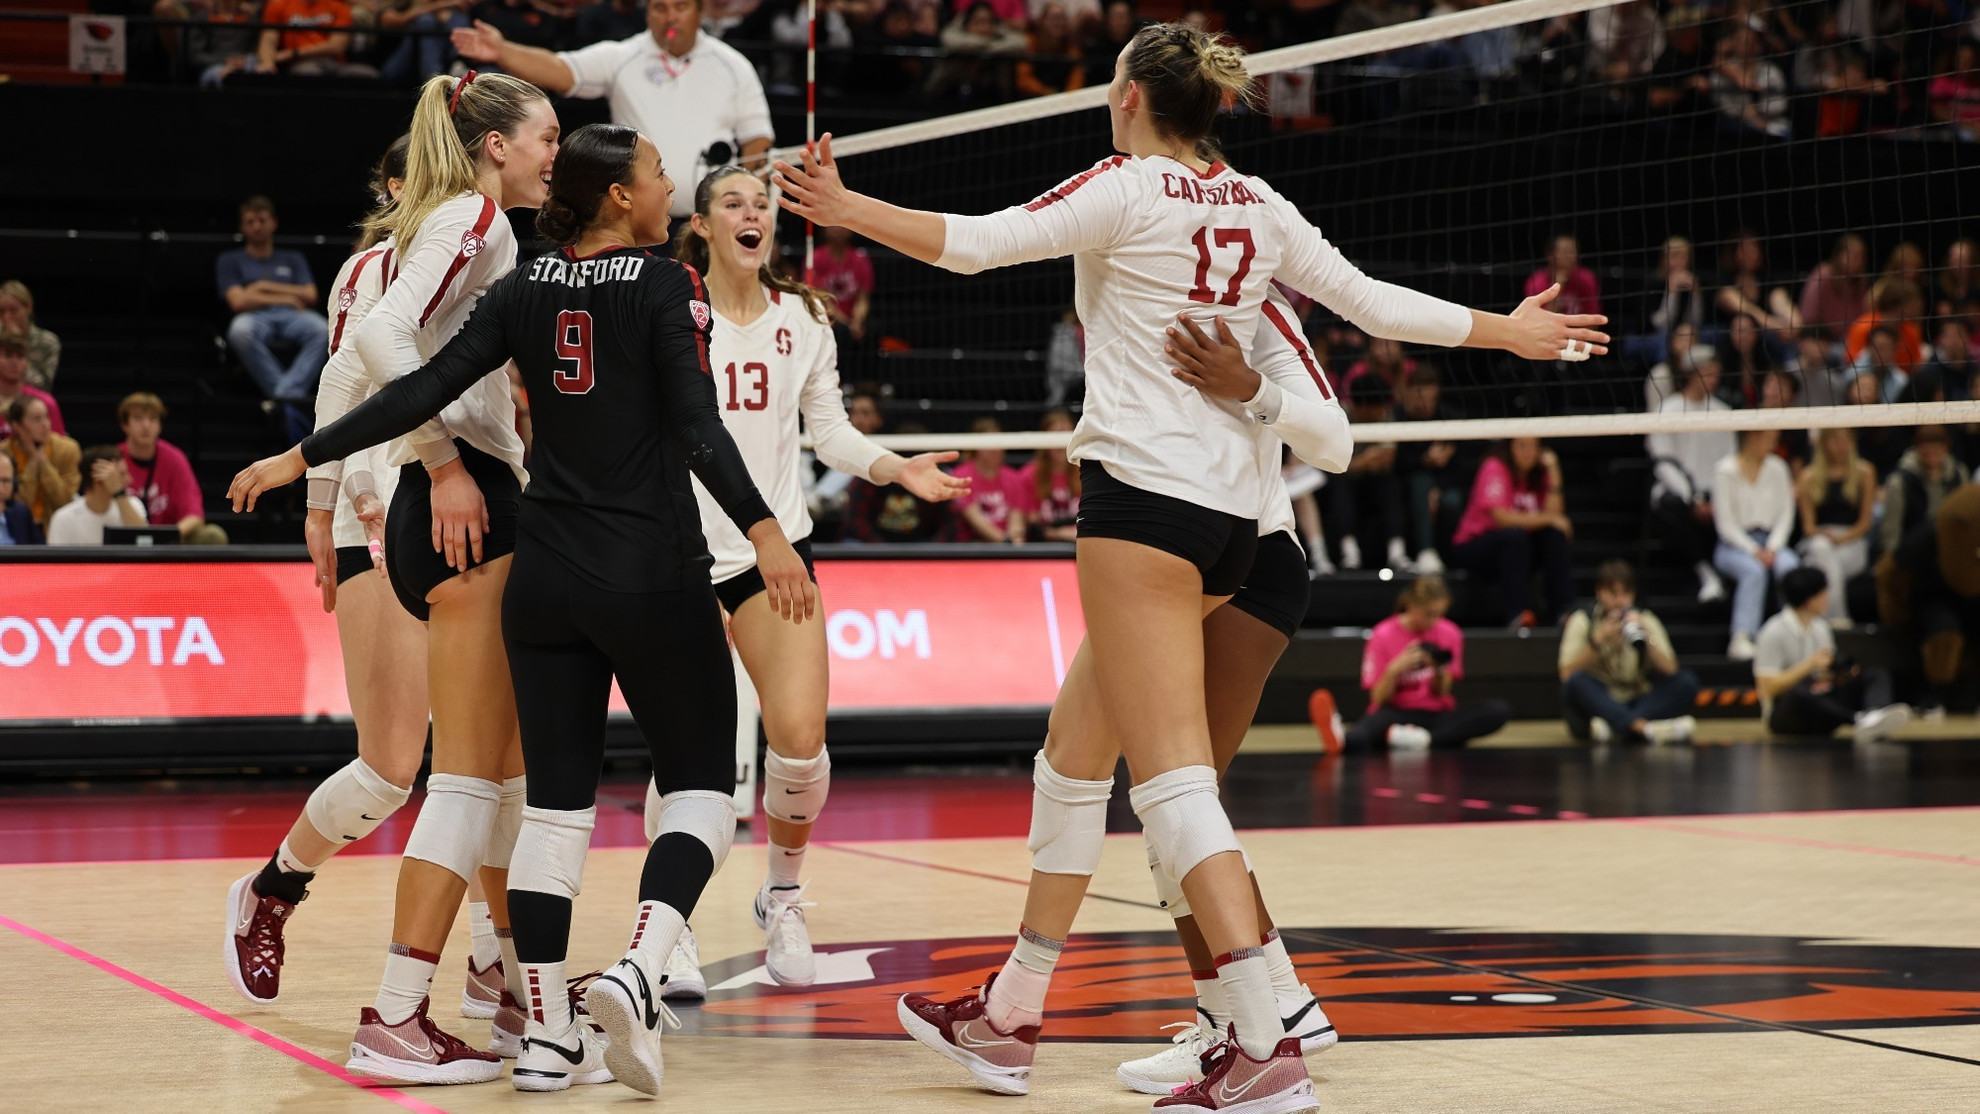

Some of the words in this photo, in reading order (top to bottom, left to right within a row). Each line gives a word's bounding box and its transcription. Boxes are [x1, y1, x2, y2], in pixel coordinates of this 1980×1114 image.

[528, 255, 645, 289] STANFORD
[1187, 225, 1257, 307] 17
[695, 312, 706, 324] 12
[552, 308, 595, 395] 9
[724, 361, 769, 411] 13
